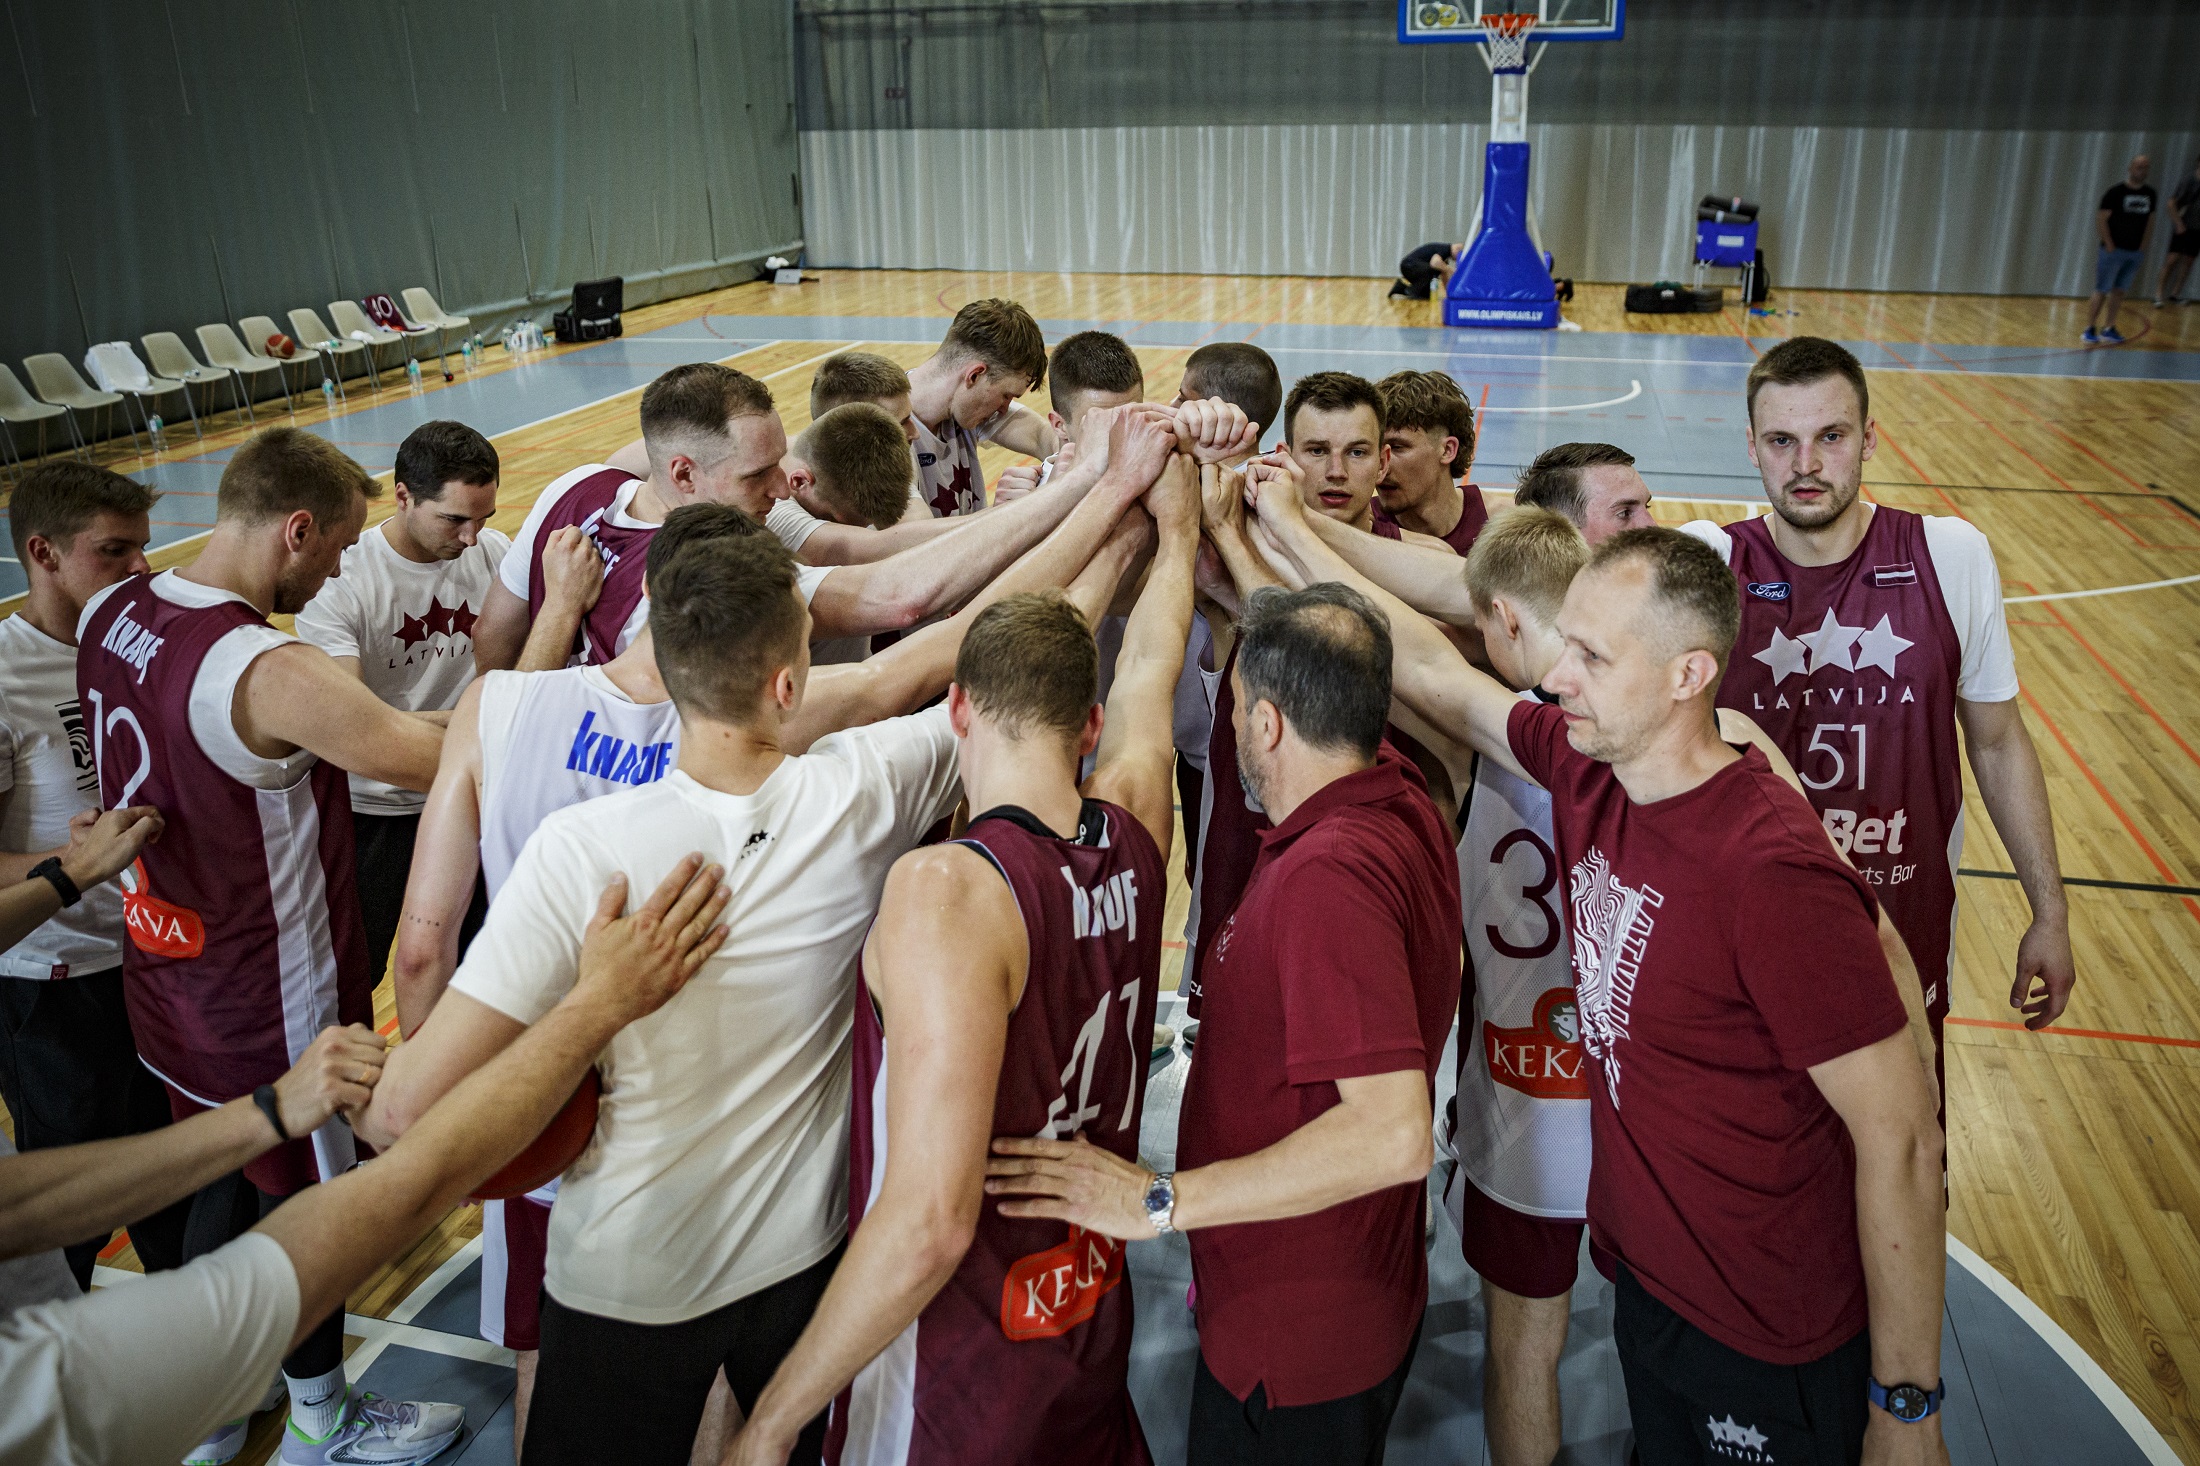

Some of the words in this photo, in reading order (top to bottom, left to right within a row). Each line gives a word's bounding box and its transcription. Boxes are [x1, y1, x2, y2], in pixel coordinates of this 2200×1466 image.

[1755, 584, 1786, 599] Ford
[1753, 685, 1915, 710] LATVIJA
[1798, 723, 1866, 790] 51
[1890, 864, 1917, 885] Bar
[123, 897, 191, 944] AVA
[1709, 1440, 1774, 1463] LATVIJA
